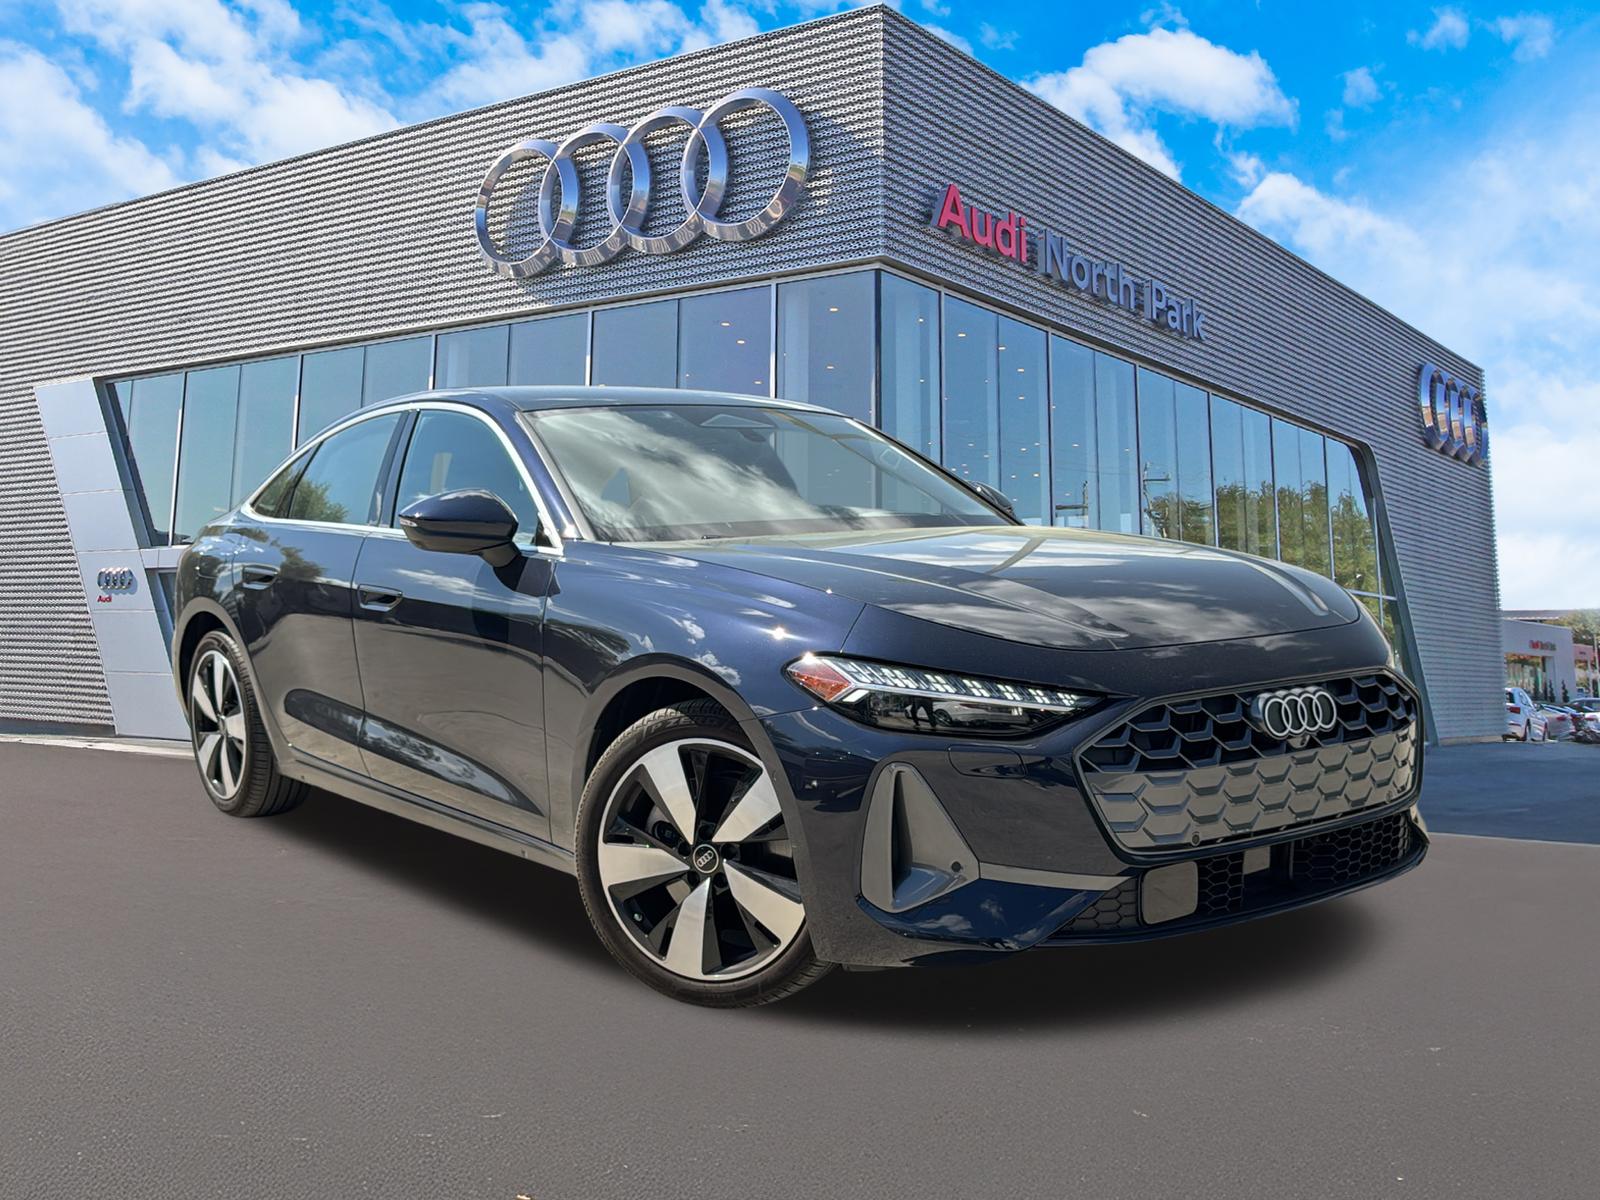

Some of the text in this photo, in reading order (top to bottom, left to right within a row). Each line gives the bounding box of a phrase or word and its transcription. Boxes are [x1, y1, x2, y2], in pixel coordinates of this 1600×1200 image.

[934, 183, 1207, 341] Audi North Park
